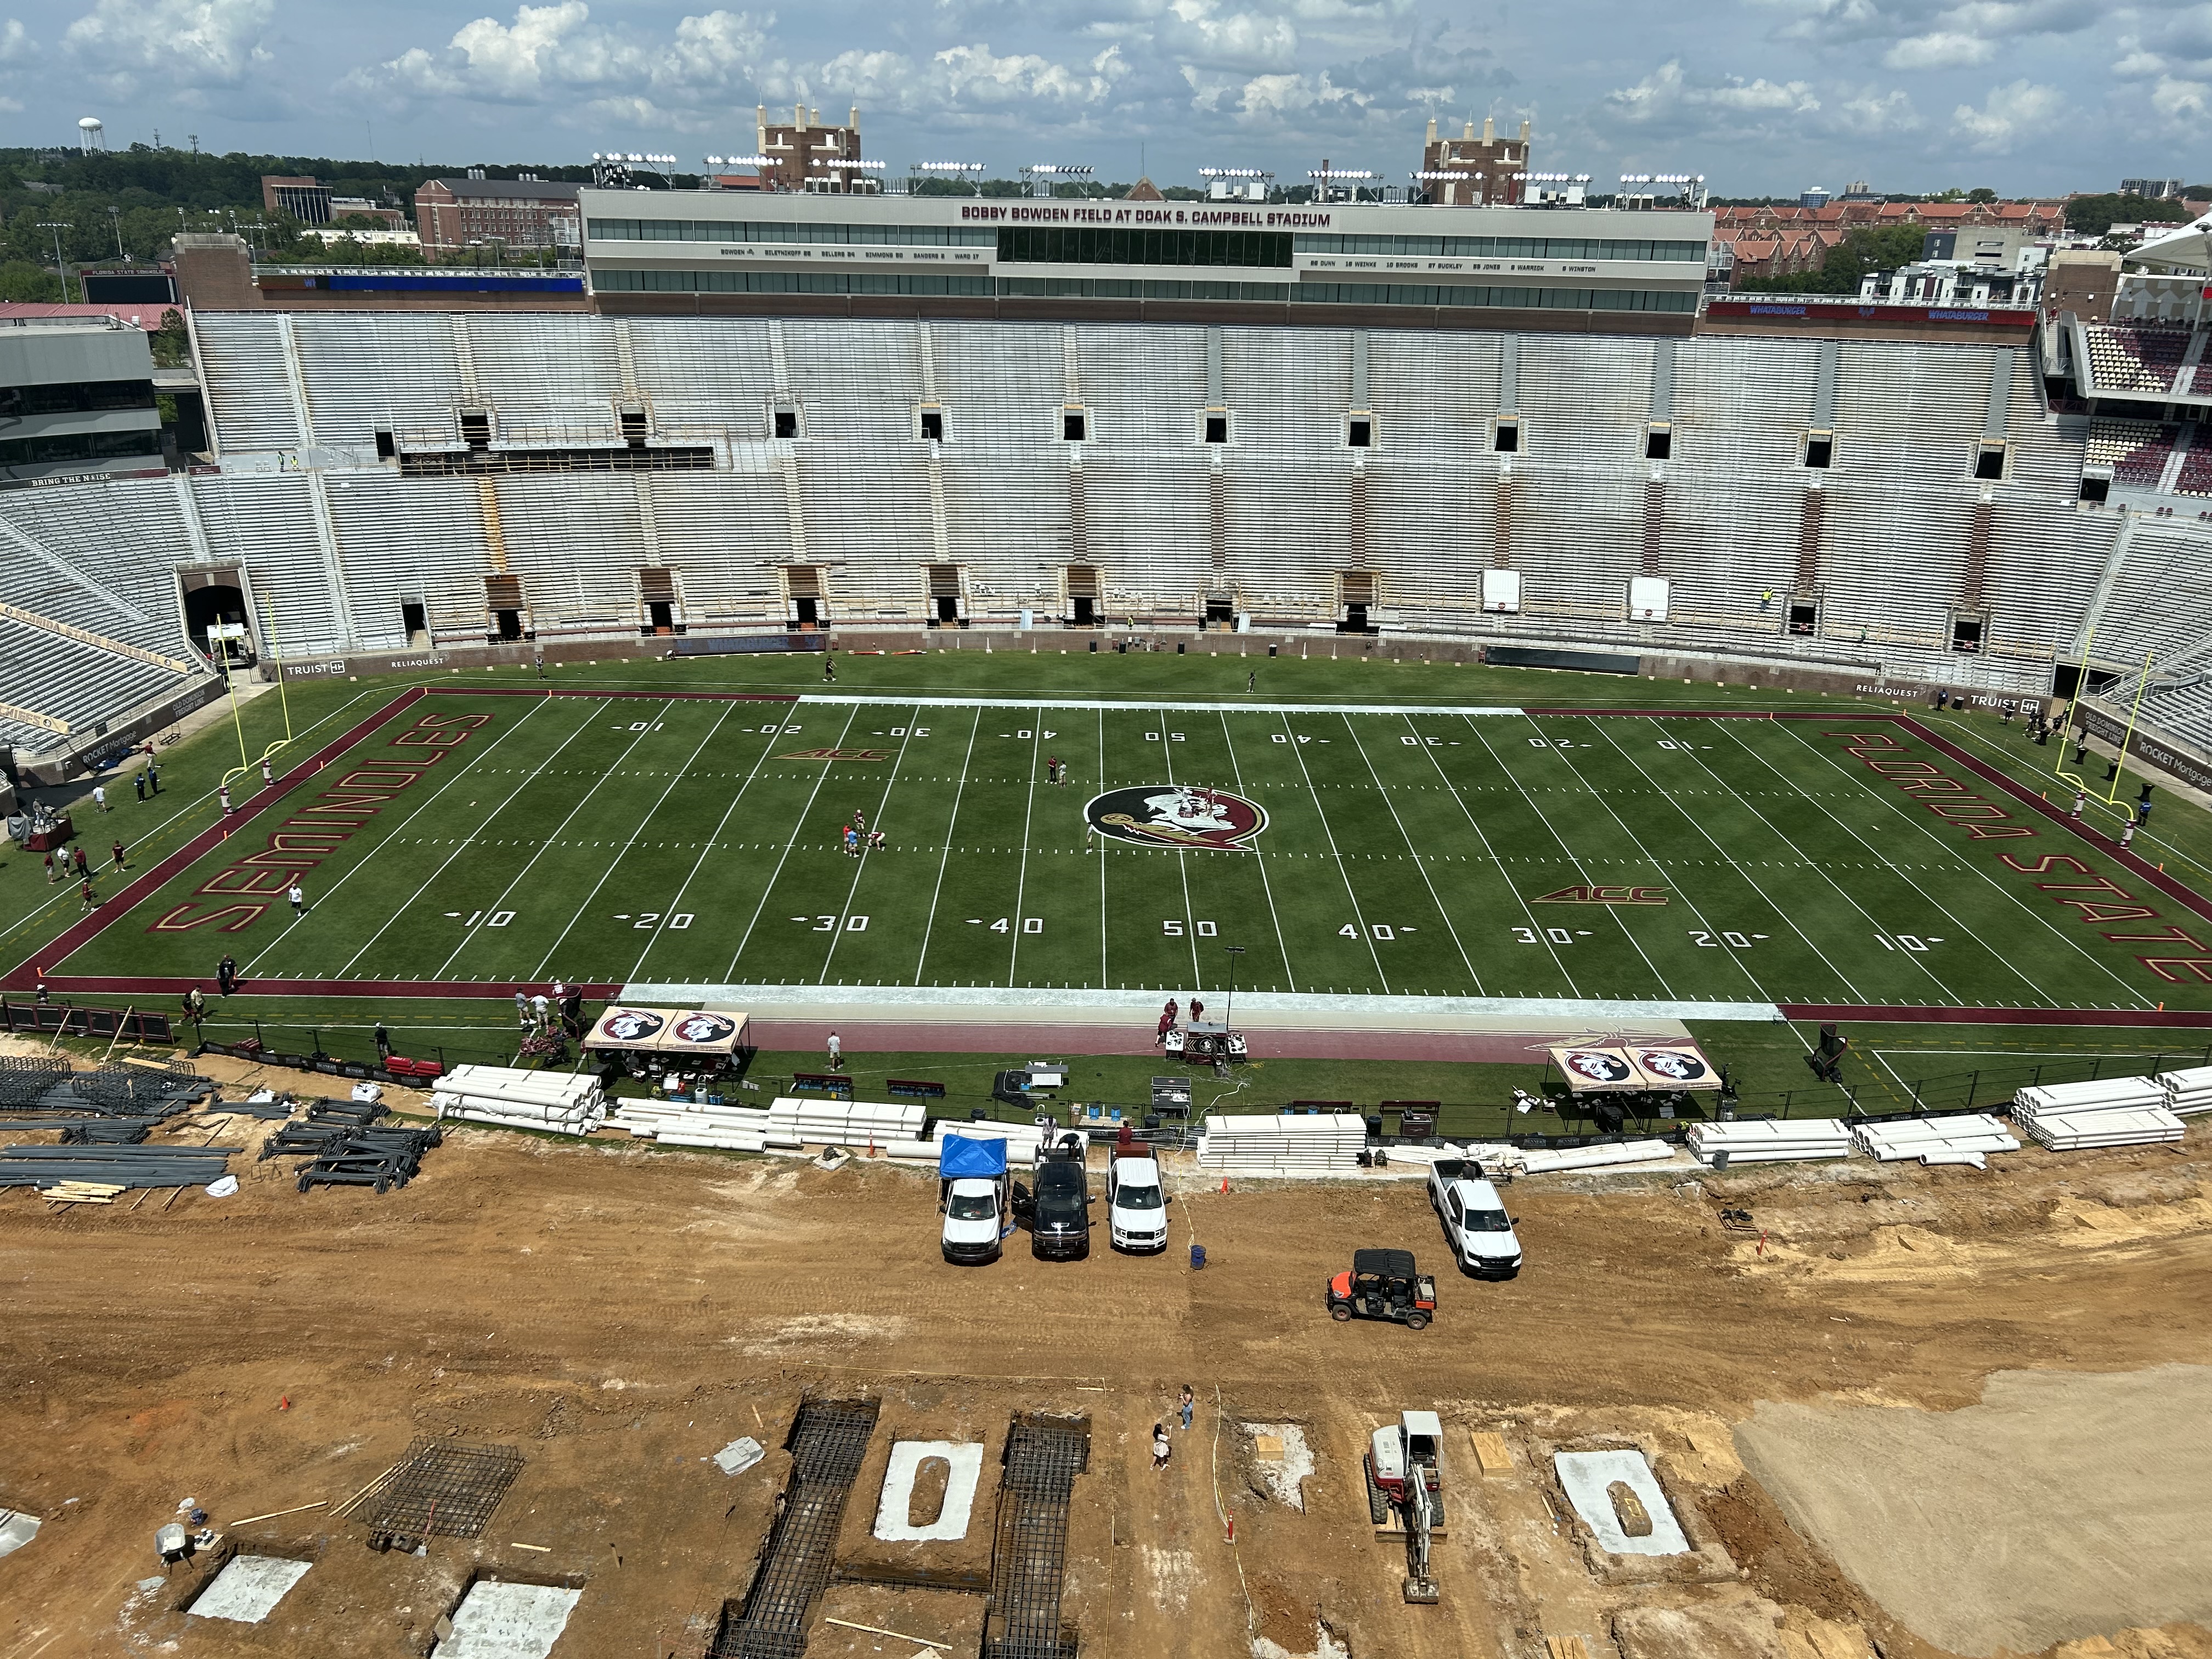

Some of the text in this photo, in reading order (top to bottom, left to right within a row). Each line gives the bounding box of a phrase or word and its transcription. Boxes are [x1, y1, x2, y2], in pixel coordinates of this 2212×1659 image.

[962, 206, 1330, 228] BOBBY BOWDEN FIELD AT DOAK S. CAMPBELL STADIUM
[1750, 305, 1807, 315] WHATABURGER
[1928, 310, 1989, 321] WHATABURGER
[31, 477, 60, 487] BRING
[62, 475, 81, 484] THE
[15, 610, 161, 664] FLORIDA STATE FOOTBALL
[287, 664, 328, 675] TRUIST
[392, 658, 444, 668] RELIAQUEST
[1857, 684, 1918, 697] RELIAQUEST
[173, 690, 205, 710] OLD DOMINION
[1971, 695, 2019, 709] TRUIST
[0, 706, 41, 725] CHIEFS
[176, 704, 194, 717] FREIGHT
[628, 721, 664, 732] 10
[759, 724, 803, 735] 20
[890, 727, 931, 737] 30
[2085, 712, 2127, 737] OLD DOMINION
[2085, 720, 2109, 738] FREIGHT
[1017, 729, 1057, 740] 40
[1144, 732, 1186, 742] 50
[1271, 733, 1312, 744] 40
[1400, 736, 1442, 747] 30
[82, 730, 137, 765] ROCKET Mortgage
[1528, 738, 1575, 748] 20
[1656, 740, 1694, 750] 10
[774, 748, 901, 761] ACC
[2139, 741, 2212, 787] ROCKET Mortgage
[146, 712, 496, 934] SEMINOLES
[1824, 730, 2212, 984] FLORIDA STATE
[1530, 885, 1672, 905] ACC
[465, 911, 517, 927] 10
[633, 913, 695, 929] 20
[812, 915, 870, 932] 30
[989, 917, 1045, 934] 40
[1163, 920, 1218, 937] 50
[1338, 923, 1396, 940] 40
[1510, 927, 1574, 944] 30
[1688, 930, 1753, 949] 20
[1872, 933, 1931, 952] 10
